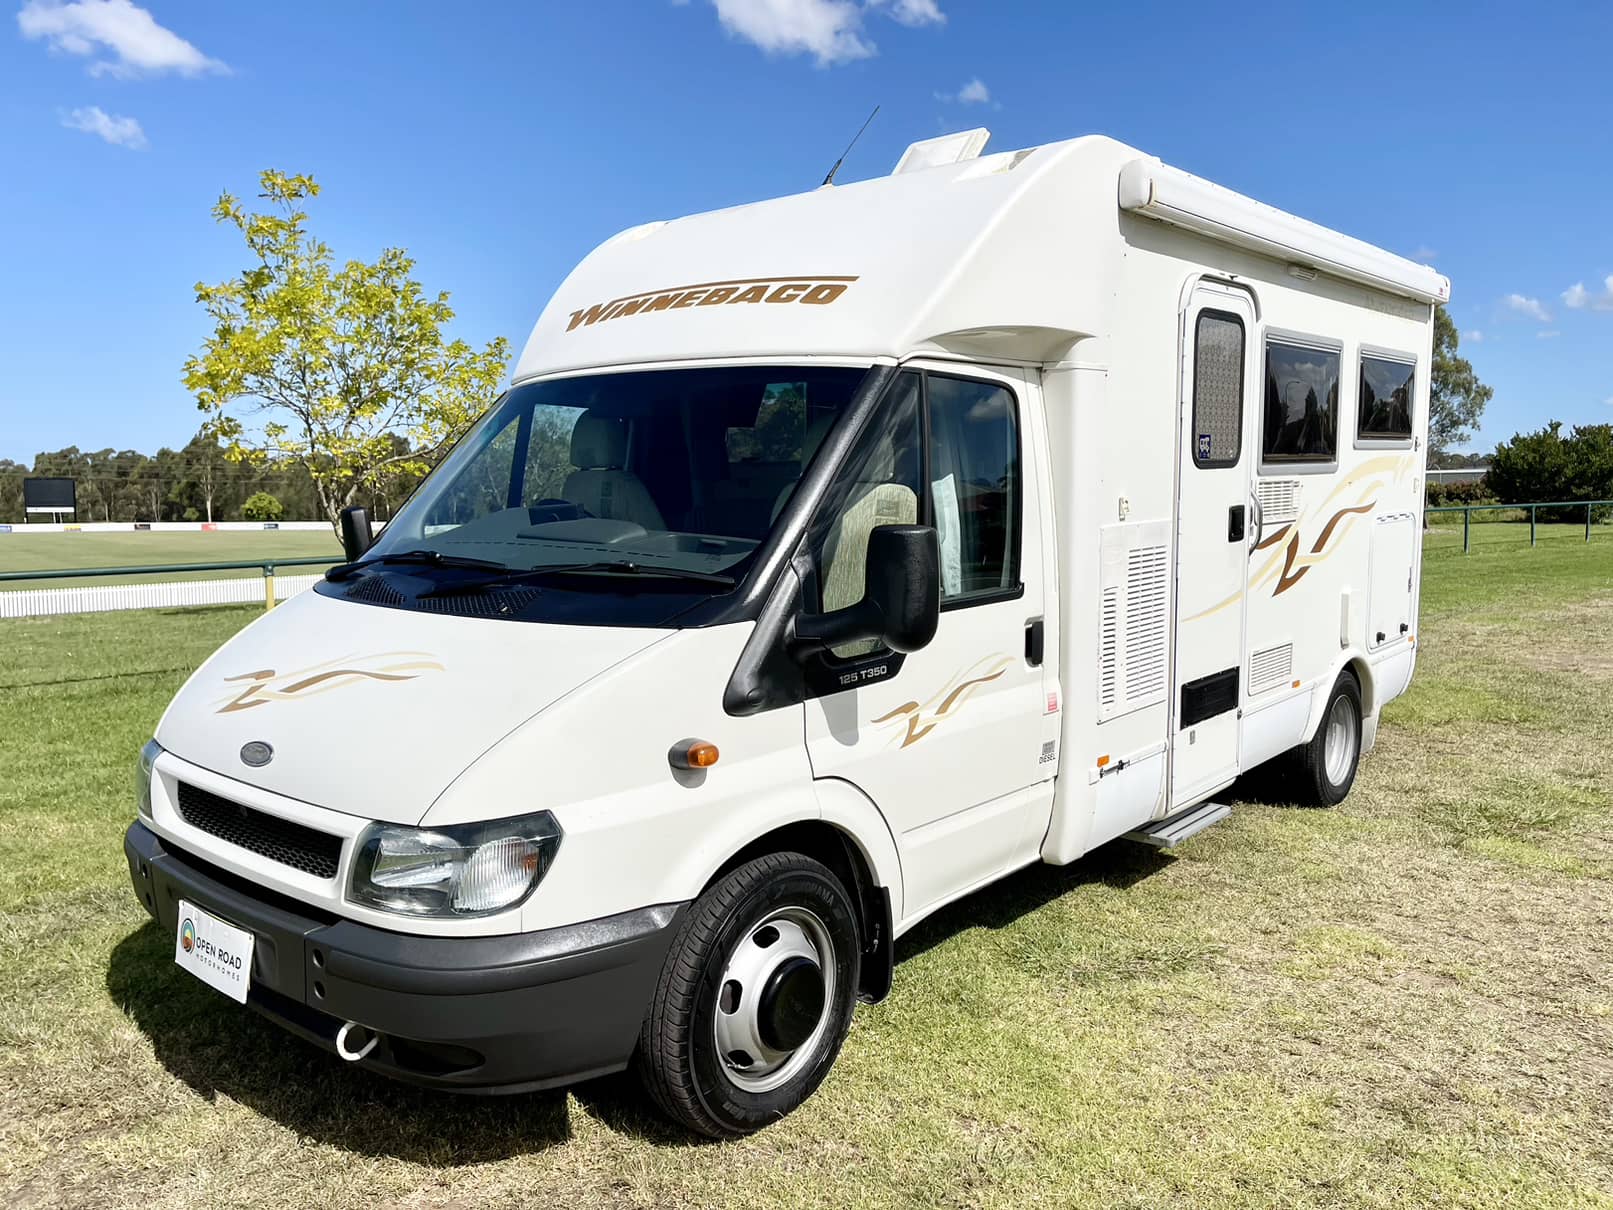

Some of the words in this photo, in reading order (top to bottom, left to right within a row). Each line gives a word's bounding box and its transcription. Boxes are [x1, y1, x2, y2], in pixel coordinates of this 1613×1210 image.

[565, 283, 849, 333] WINNEBAGO
[838, 671, 858, 685] 125
[860, 665, 888, 680] T350
[196, 937, 217, 957] OPEN
[218, 948, 242, 970] ROAD
